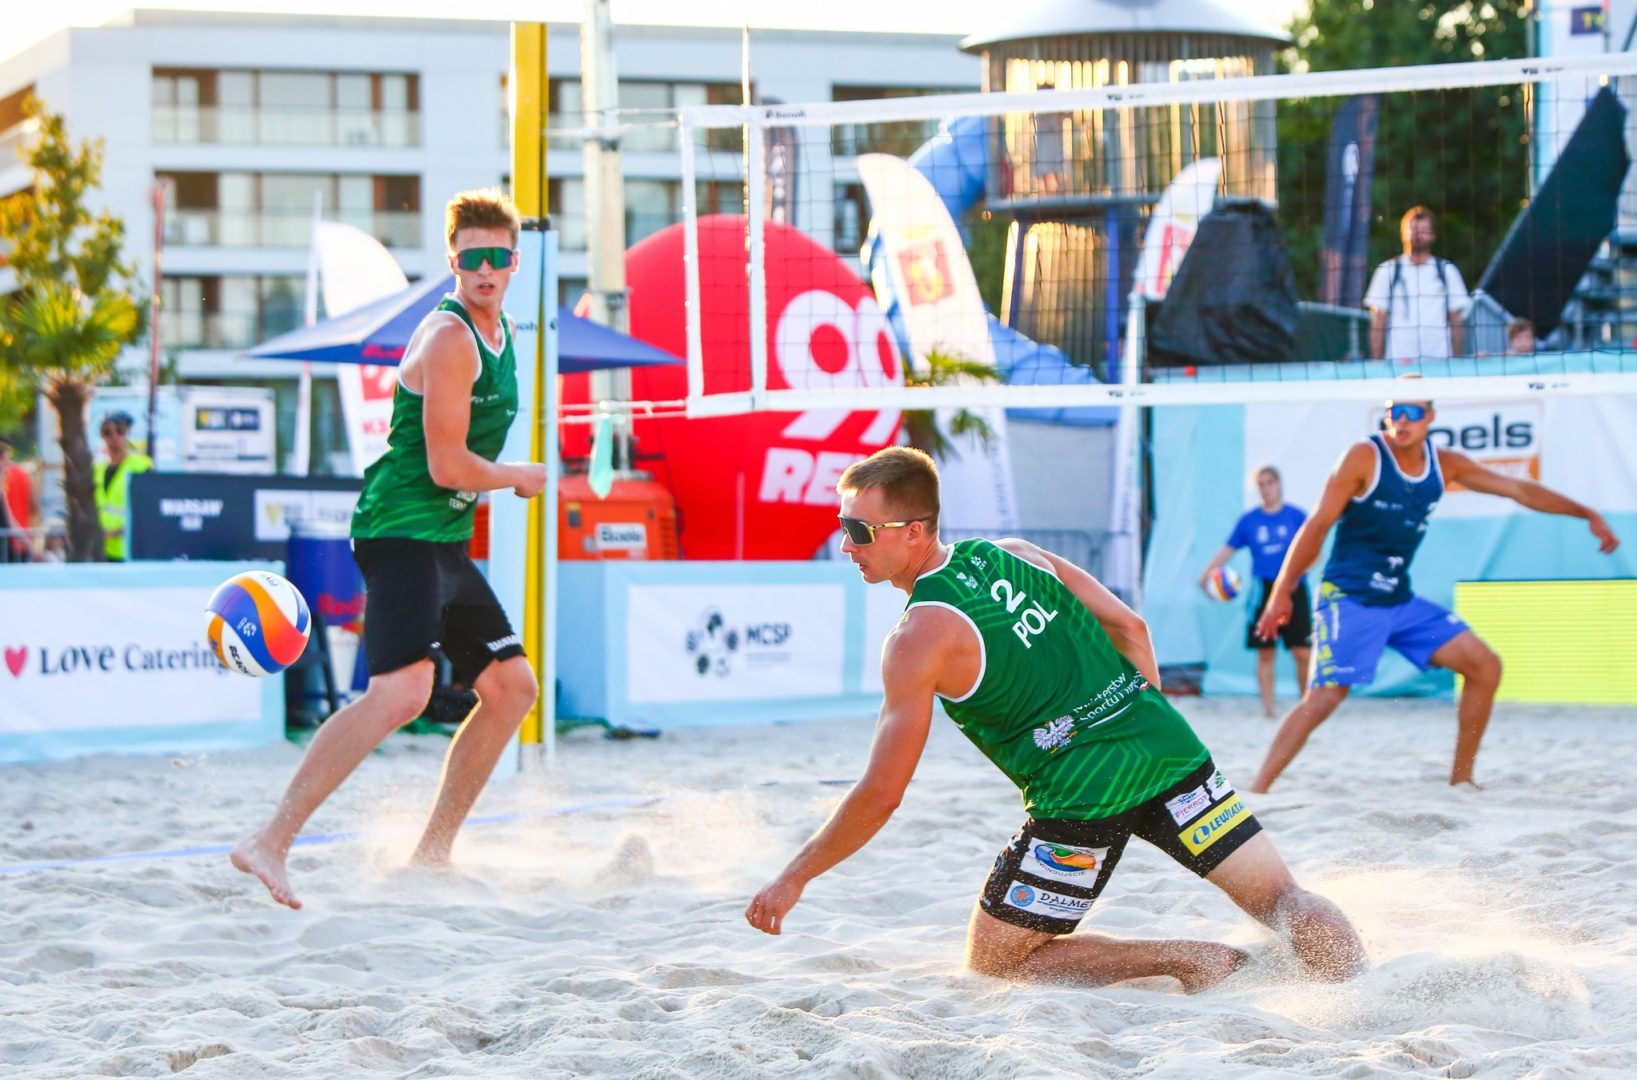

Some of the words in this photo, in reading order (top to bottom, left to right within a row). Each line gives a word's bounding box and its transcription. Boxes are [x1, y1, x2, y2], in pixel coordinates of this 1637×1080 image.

[775, 290, 903, 446] 99
[758, 447, 869, 507] RE
[991, 579, 1027, 614] 2
[1012, 600, 1059, 649] POL
[1174, 795, 1208, 819] PIERROT
[1040, 892, 1095, 909] DALME
